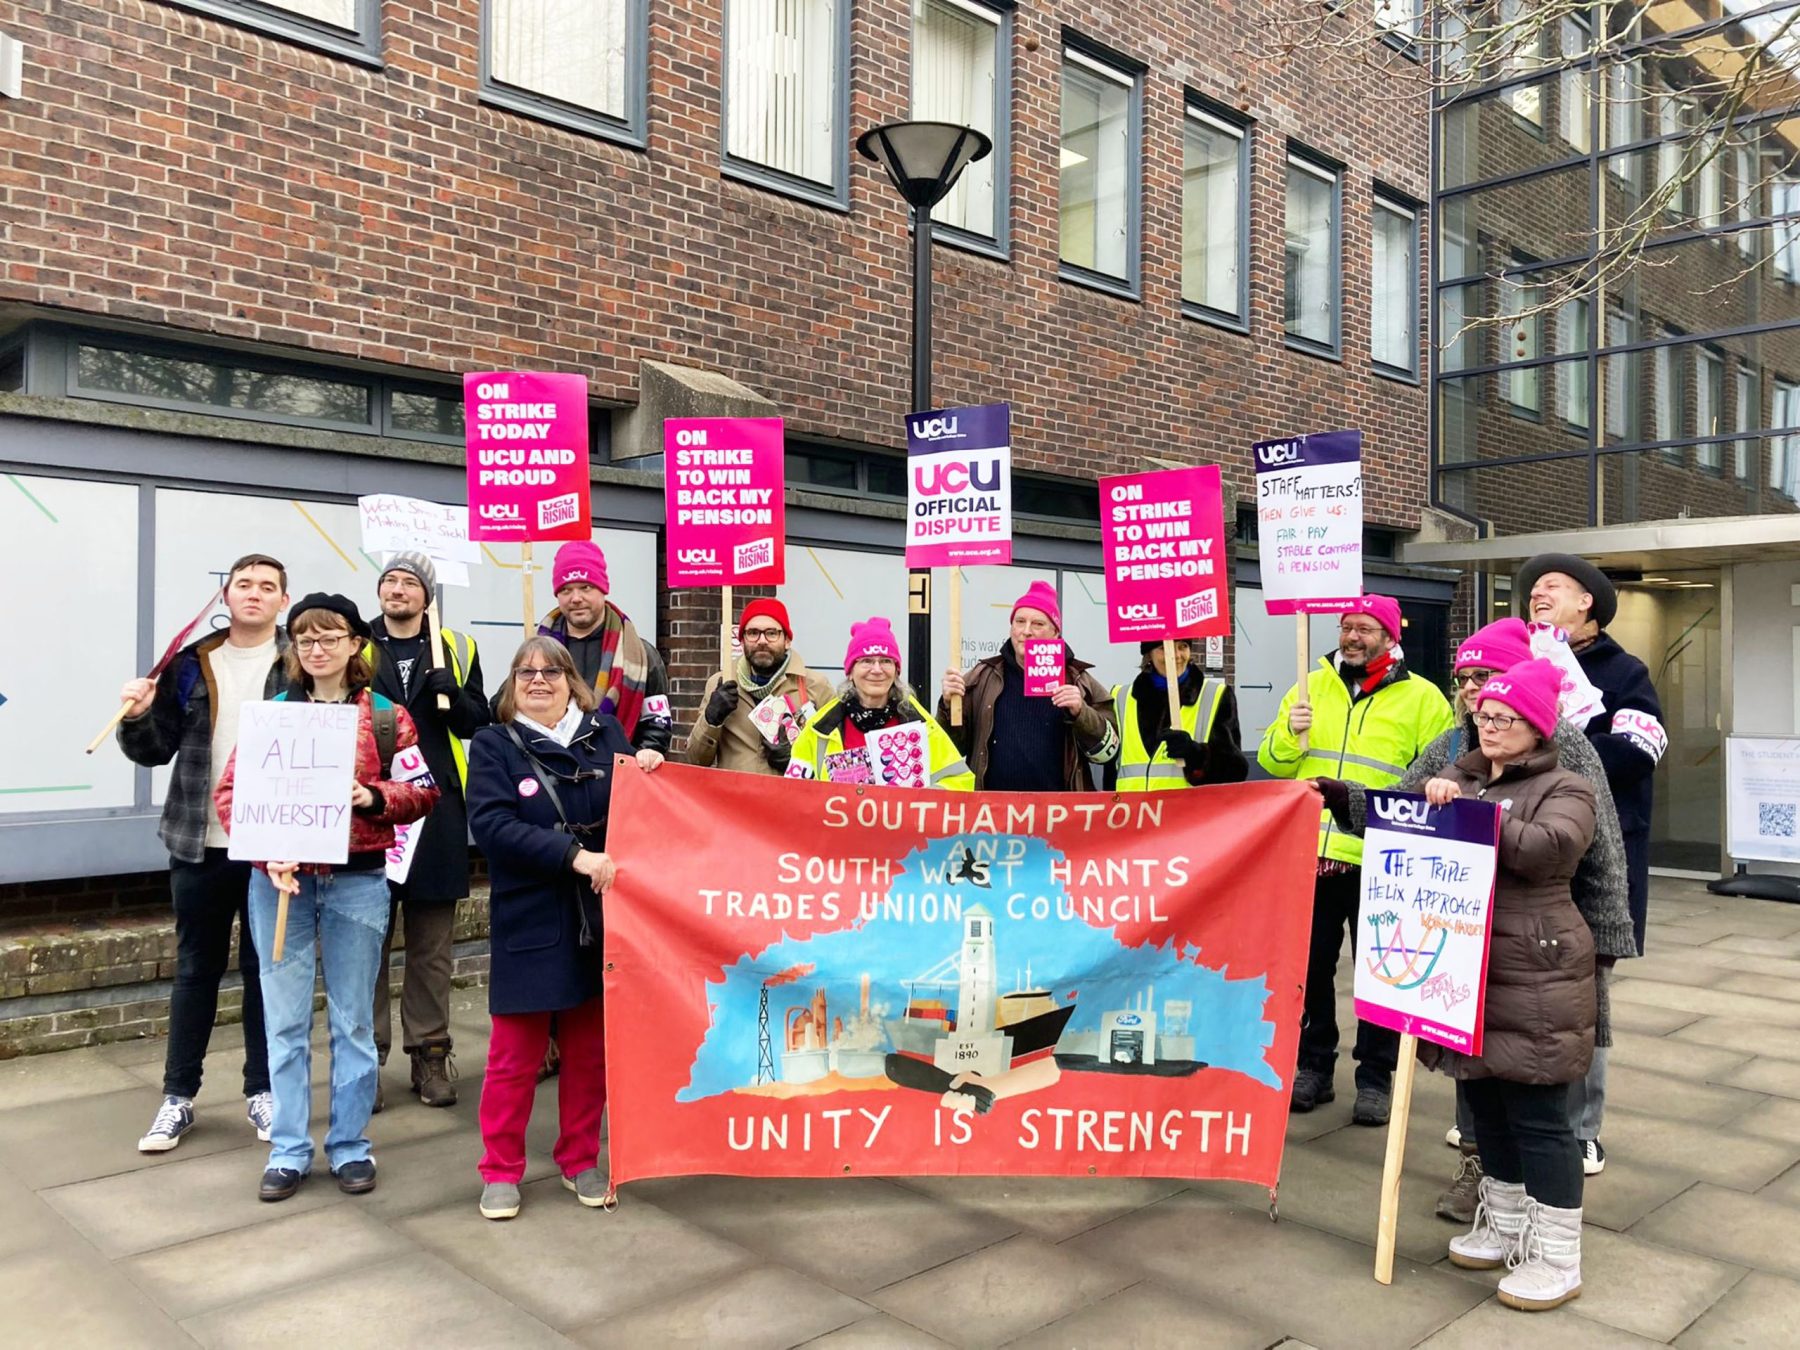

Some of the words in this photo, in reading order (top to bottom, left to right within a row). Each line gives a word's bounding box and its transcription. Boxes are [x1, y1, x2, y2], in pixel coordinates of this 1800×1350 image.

[476, 383, 509, 400] ON
[477, 403, 557, 420] STRIKE
[477, 423, 551, 440] TODAY
[912, 416, 958, 439] UCU
[676, 430, 707, 446] ON
[478, 449, 525, 466] UCU
[528, 449, 576, 465] AND
[676, 449, 754, 466] STRIKE
[1257, 441, 1298, 464] UCU
[479, 469, 557, 486] PROUD
[676, 469, 705, 485] TO
[708, 469, 750, 485] WIN
[914, 459, 1001, 496] UCU
[1110, 484, 1143, 502] ON
[1261, 475, 1302, 497] STAFF
[1295, 477, 1361, 500] MATTERS?
[542, 498, 574, 510] UCU
[677, 489, 737, 506] BACK
[740, 489, 773, 505] MY
[360, 499, 402, 514] Work
[479, 503, 519, 518] UCU
[914, 496, 1002, 517] OFFICIAL
[1112, 500, 1192, 522] STRIKE
[1259, 507, 1282, 522] THEN
[1290, 505, 1316, 519] GIVE
[542, 506, 575, 525] RISING
[678, 508, 773, 525] PENSION
[914, 516, 1001, 537] DISPUTE
[1113, 525, 1143, 542] TO
[1145, 520, 1190, 539] WIN
[1276, 528, 1297, 543] FAIR
[1307, 526, 1328, 539] PAY
[677, 548, 716, 563] UCU
[738, 543, 769, 555] UCU
[1115, 542, 1177, 562] BACK
[1179, 538, 1214, 556] MY
[1277, 545, 1313, 558] STABLE
[738, 550, 770, 569] RISING
[1278, 561, 1285, 574] A
[1290, 560, 1341, 573] PENSION
[562, 570, 589, 581] UCU
[1116, 558, 1214, 582] PENSION
[1180, 594, 1212, 608] UCU
[1117, 603, 1158, 619] UCU
[1181, 601, 1213, 622] RISING
[862, 644, 889, 655] UCU
[960, 637, 977, 652] his
[978, 640, 1001, 655] way
[1027, 643, 1063, 655] JOIN
[1035, 655, 1055, 666] US
[1027, 666, 1062, 677] NOW
[251, 707, 294, 728] WE
[307, 707, 351, 730] ARE
[261, 737, 339, 770] ALL
[267, 776, 317, 796] THE
[234, 802, 347, 829] UNIVERSITY
[822, 795, 1164, 834] SOUTHAMPTON
[1373, 795, 1430, 824] UCU
[948, 839, 1027, 861] AND
[777, 852, 891, 886] SOUTH
[920, 859, 1024, 888] WEST
[1050, 856, 1190, 888] HANTS
[1379, 848, 1414, 877] THE
[698, 889, 841, 921] TRADES
[860, 891, 964, 925] UNION
[1006, 892, 1169, 923] COUNCIL
[1412, 886, 1482, 917] APPROACH
[1367, 909, 1400, 927] WORK
[1117, 1014, 1141, 1025] Ford
[959, 1042, 976, 1050] EST
[954, 1050, 979, 1060] 1890
[728, 1104, 893, 1151] UNITY
[934, 1108, 976, 1147] IS
[1017, 1107, 1252, 1156] STRENGTH
